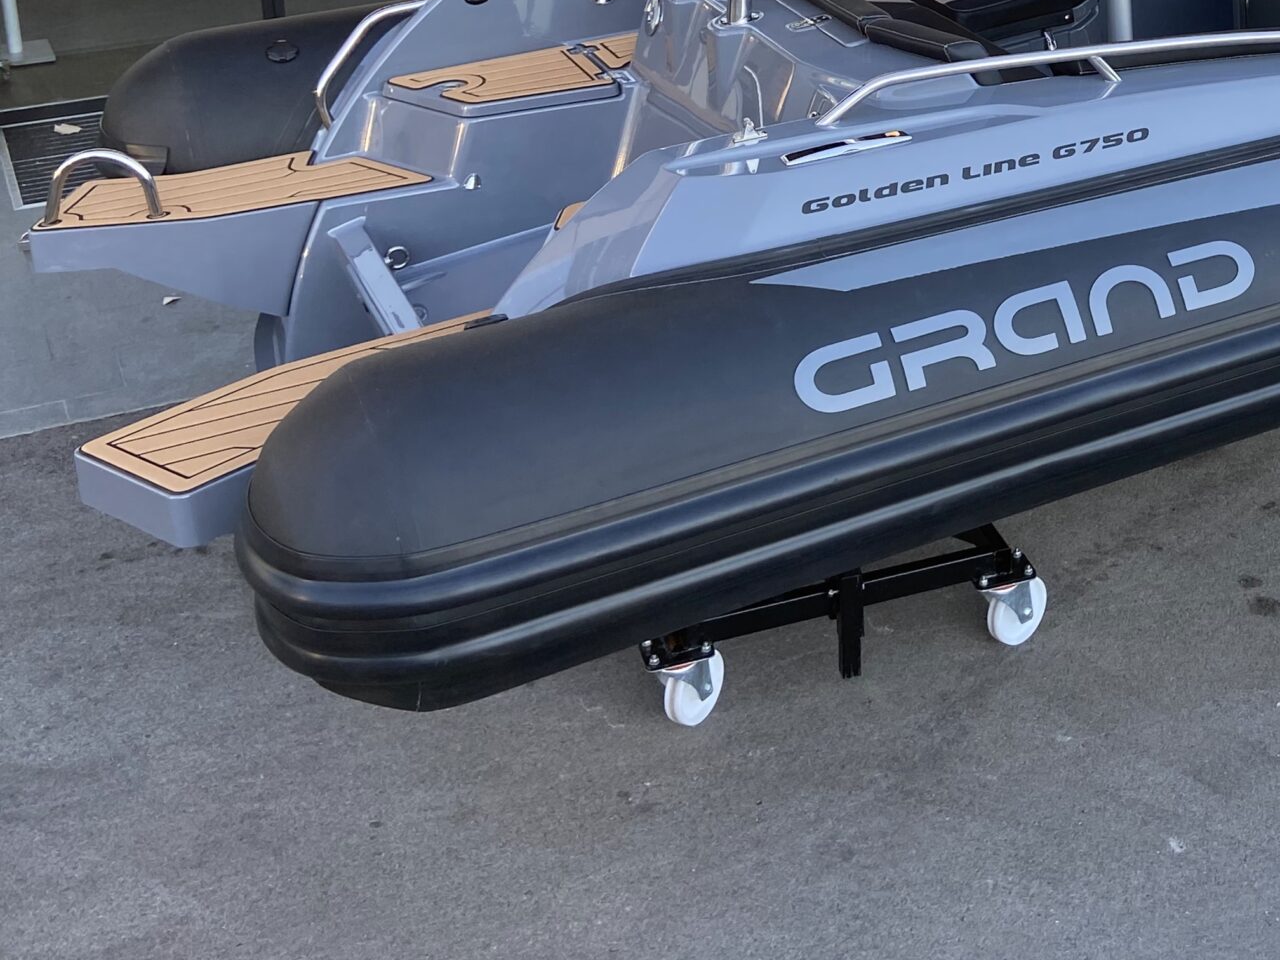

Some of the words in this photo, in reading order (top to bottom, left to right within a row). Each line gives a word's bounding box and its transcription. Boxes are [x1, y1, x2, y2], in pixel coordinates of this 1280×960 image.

[801, 173, 950, 215] Golden
[961, 152, 1041, 181] Line
[1052, 127, 1150, 160] G750
[793, 240, 1256, 414] GRAND
